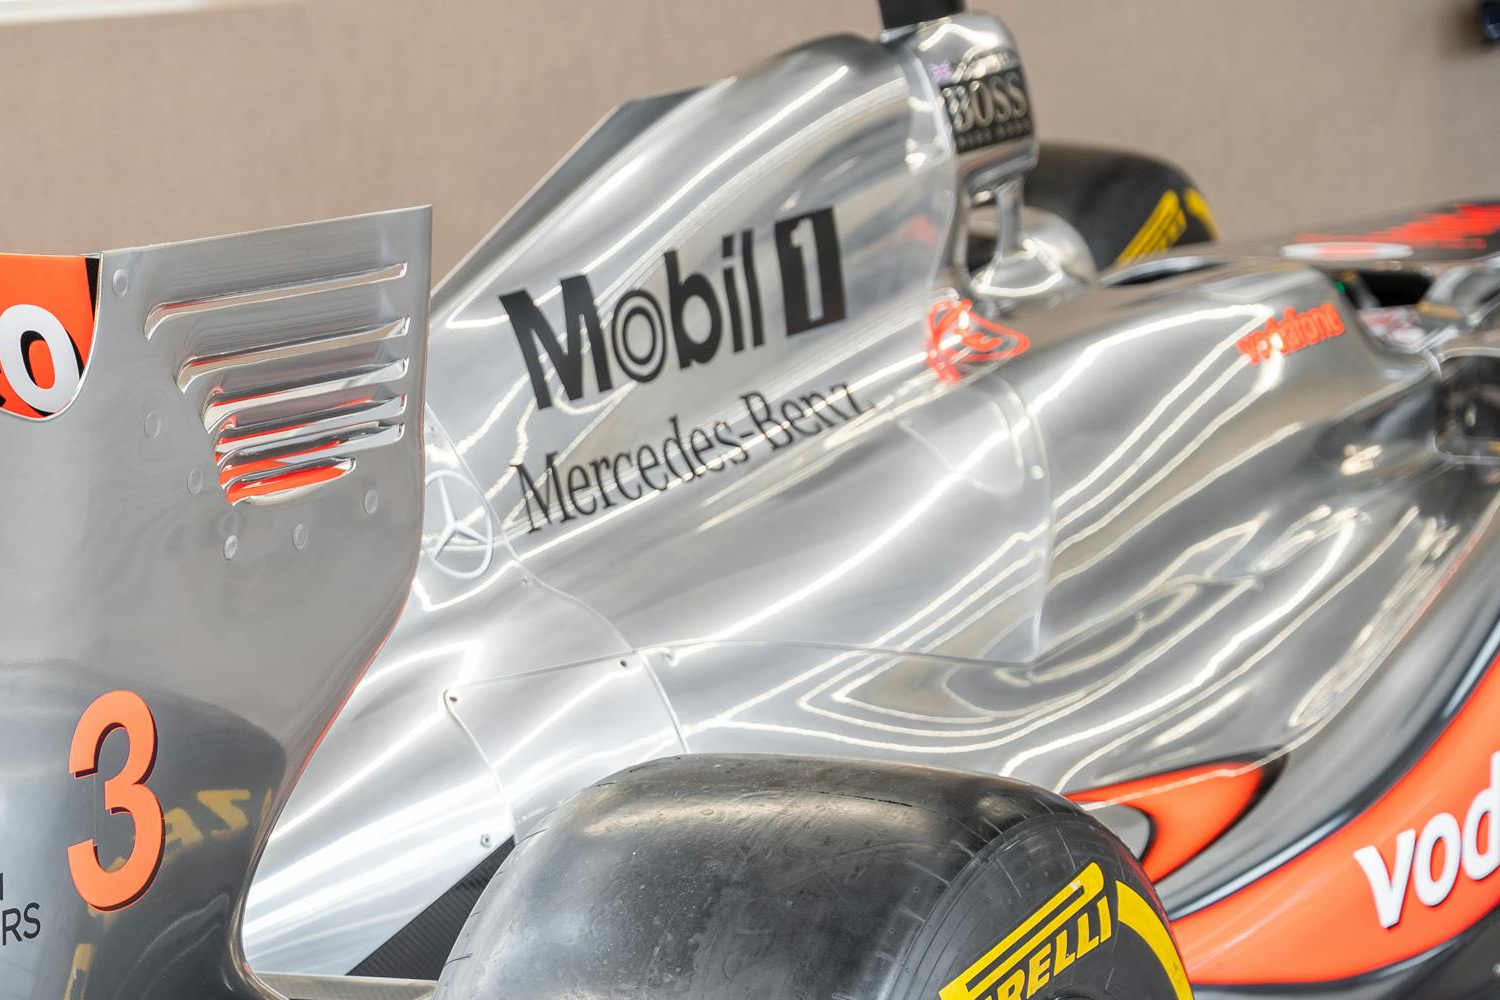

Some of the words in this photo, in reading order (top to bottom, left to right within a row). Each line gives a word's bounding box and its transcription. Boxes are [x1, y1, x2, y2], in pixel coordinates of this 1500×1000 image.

[941, 71, 1028, 134] BOSS
[497, 229, 765, 411] Mobil
[510, 383, 876, 535] Mercedes-Benz
[67, 689, 167, 912] 3
